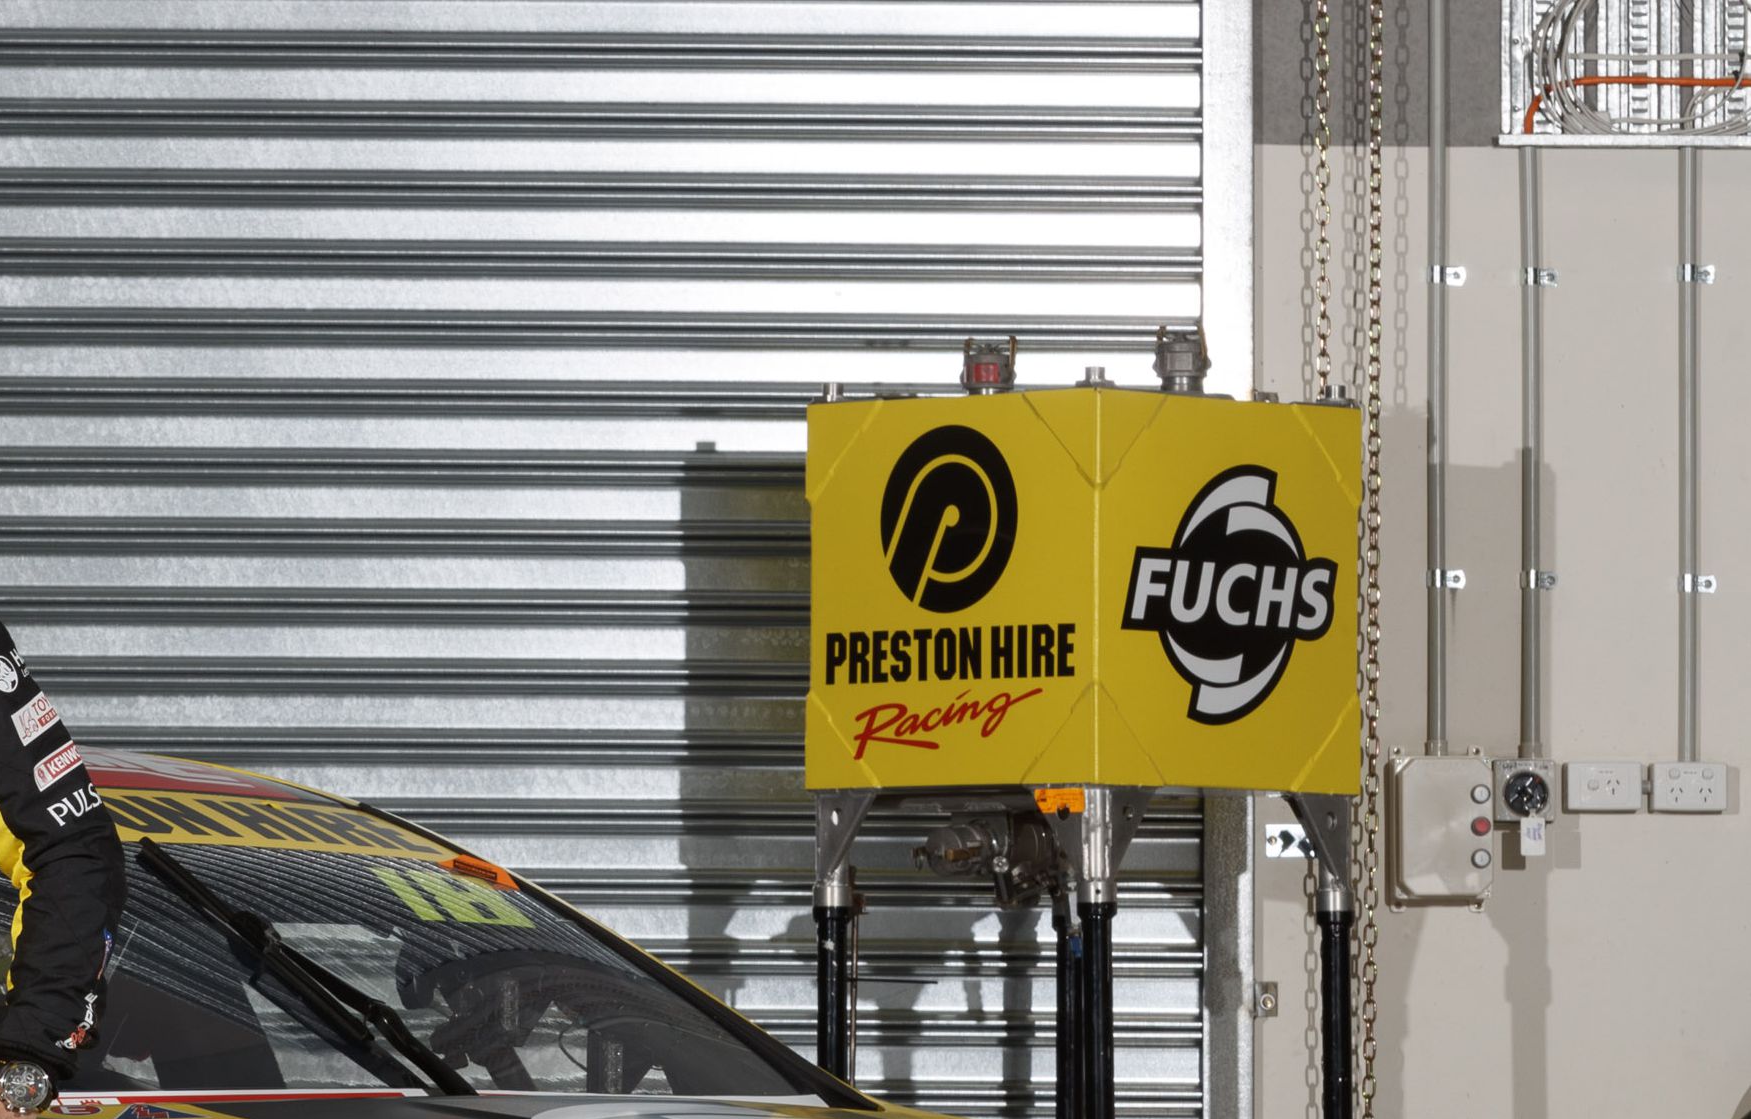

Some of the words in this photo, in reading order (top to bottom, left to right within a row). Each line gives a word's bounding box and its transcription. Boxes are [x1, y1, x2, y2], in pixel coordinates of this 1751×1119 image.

[1130, 556, 1332, 631] FUCHS
[825, 625, 982, 685] PRESTON
[990, 623, 1076, 678] HIRE
[853, 688, 1043, 760] Racing
[46, 782, 102, 828] PULS
[193, 798, 443, 852] HIRE
